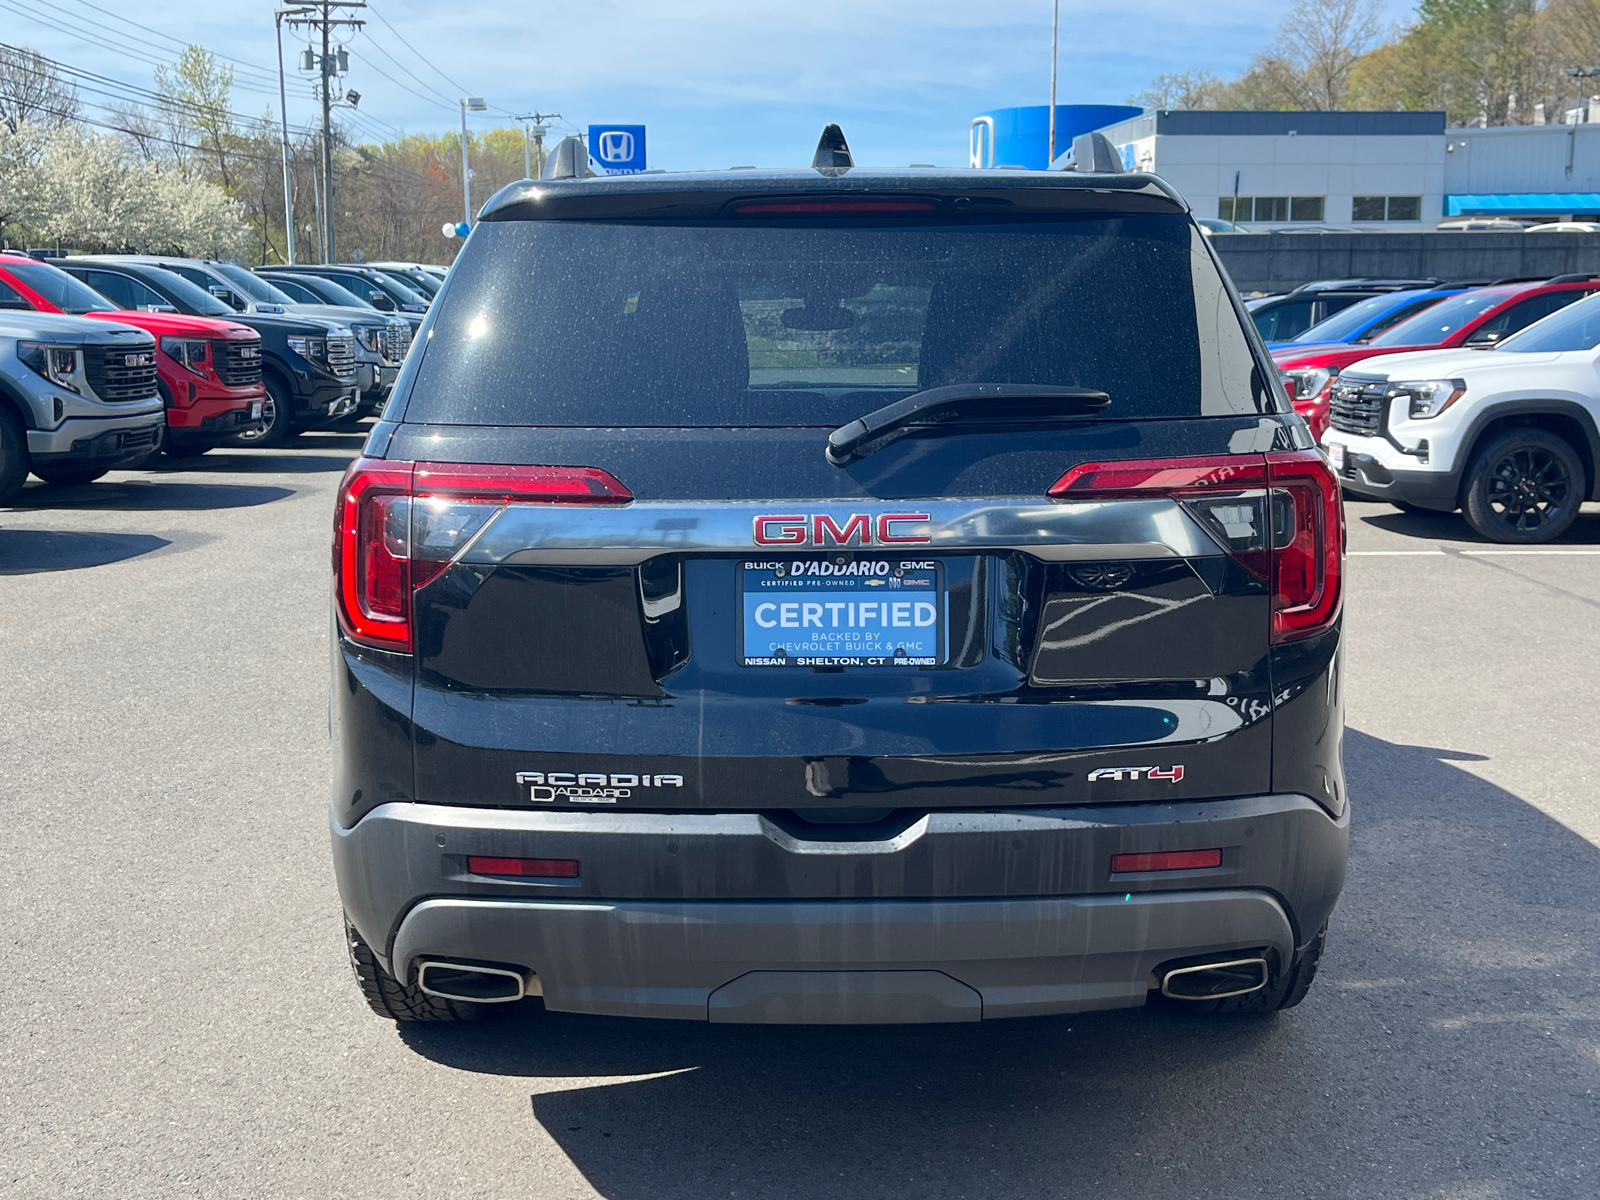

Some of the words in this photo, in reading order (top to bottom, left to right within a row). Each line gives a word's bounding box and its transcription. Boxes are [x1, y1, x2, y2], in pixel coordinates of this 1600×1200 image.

[752, 512, 932, 547] GMC
[744, 561, 785, 570] BUICK
[790, 560, 890, 577] D'ADDARIO
[900, 561, 935, 570] GMC
[754, 602, 937, 628] CERTIFIED
[811, 632, 861, 641] BACKED
[865, 632, 881, 641] BY
[769, 642, 841, 651] CHEVROLET
[845, 642, 882, 651] BUICK
[885, 642, 893, 651] &
[896, 641, 923, 651] GMC
[745, 658, 786, 666] NISSAN
[796, 658, 864, 666] SHELTON,
[893, 658, 936, 666] PRE-OWNED
[515, 771, 684, 788] ACADIA
[1087, 765, 1185, 784] AT4
[530, 785, 632, 802] D'ADDARIO
